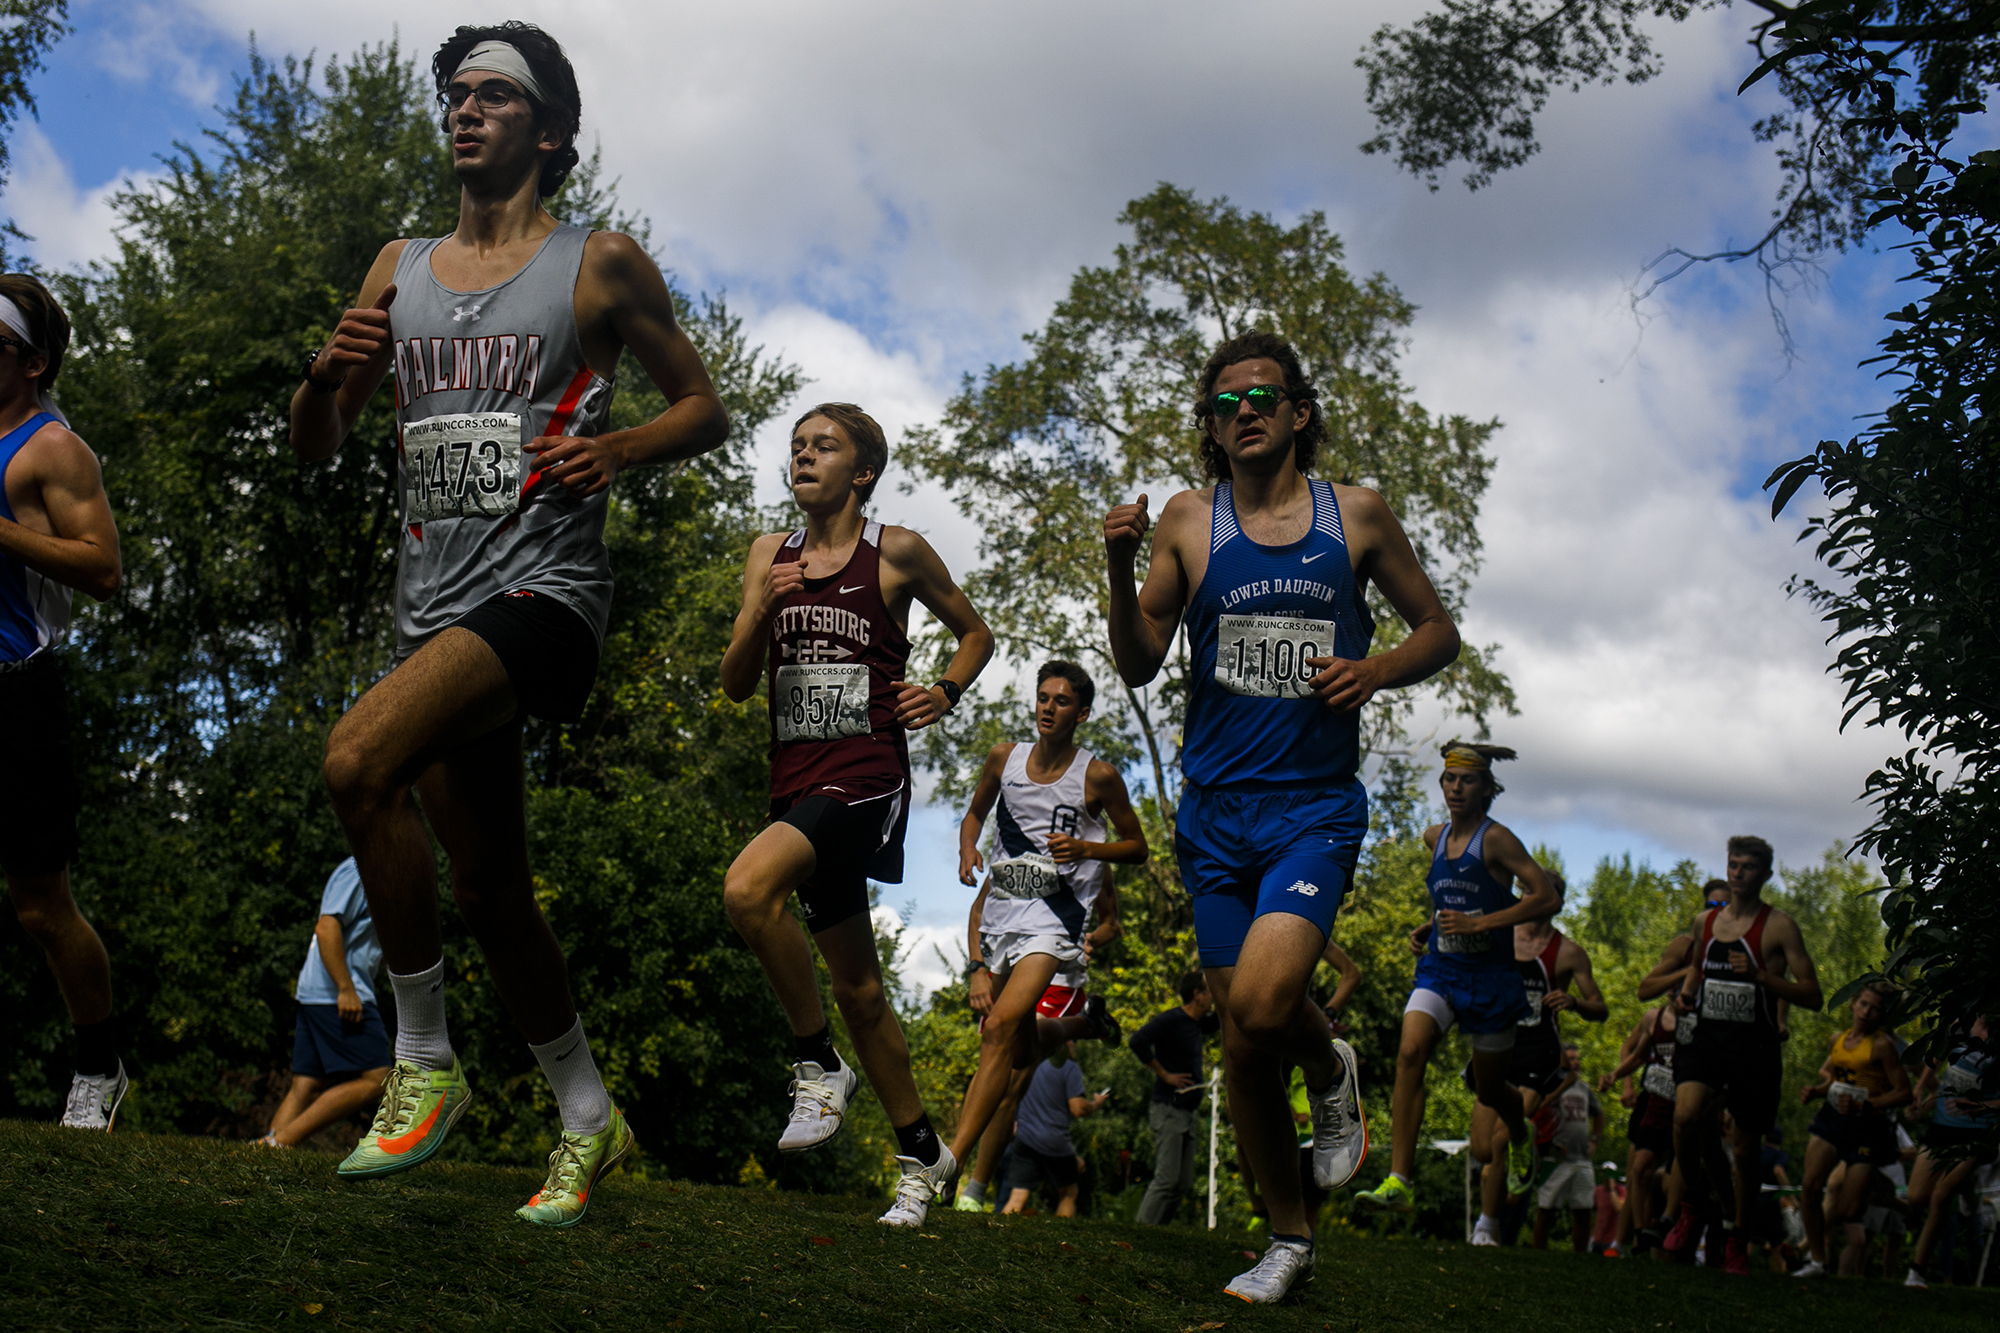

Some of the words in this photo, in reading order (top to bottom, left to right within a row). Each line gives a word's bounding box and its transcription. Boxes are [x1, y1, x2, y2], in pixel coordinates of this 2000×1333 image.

[395, 334, 541, 411] PALMYRA
[408, 418, 508, 436] WWW.RUNCCRS.COM
[414, 440, 503, 501] 1473
[1221, 580, 1271, 609] LOWER
[1274, 579, 1336, 604] DAUPHIN
[1227, 619, 1326, 633] WWW.RUNCCRS.COM
[780, 667, 861, 677] WWW.RUNCCRS.COM
[1232, 638, 1318, 684] 1100
[790, 684, 844, 725] 857
[1003, 864, 1043, 889] 378
[1707, 990, 1748, 1014] 3092
